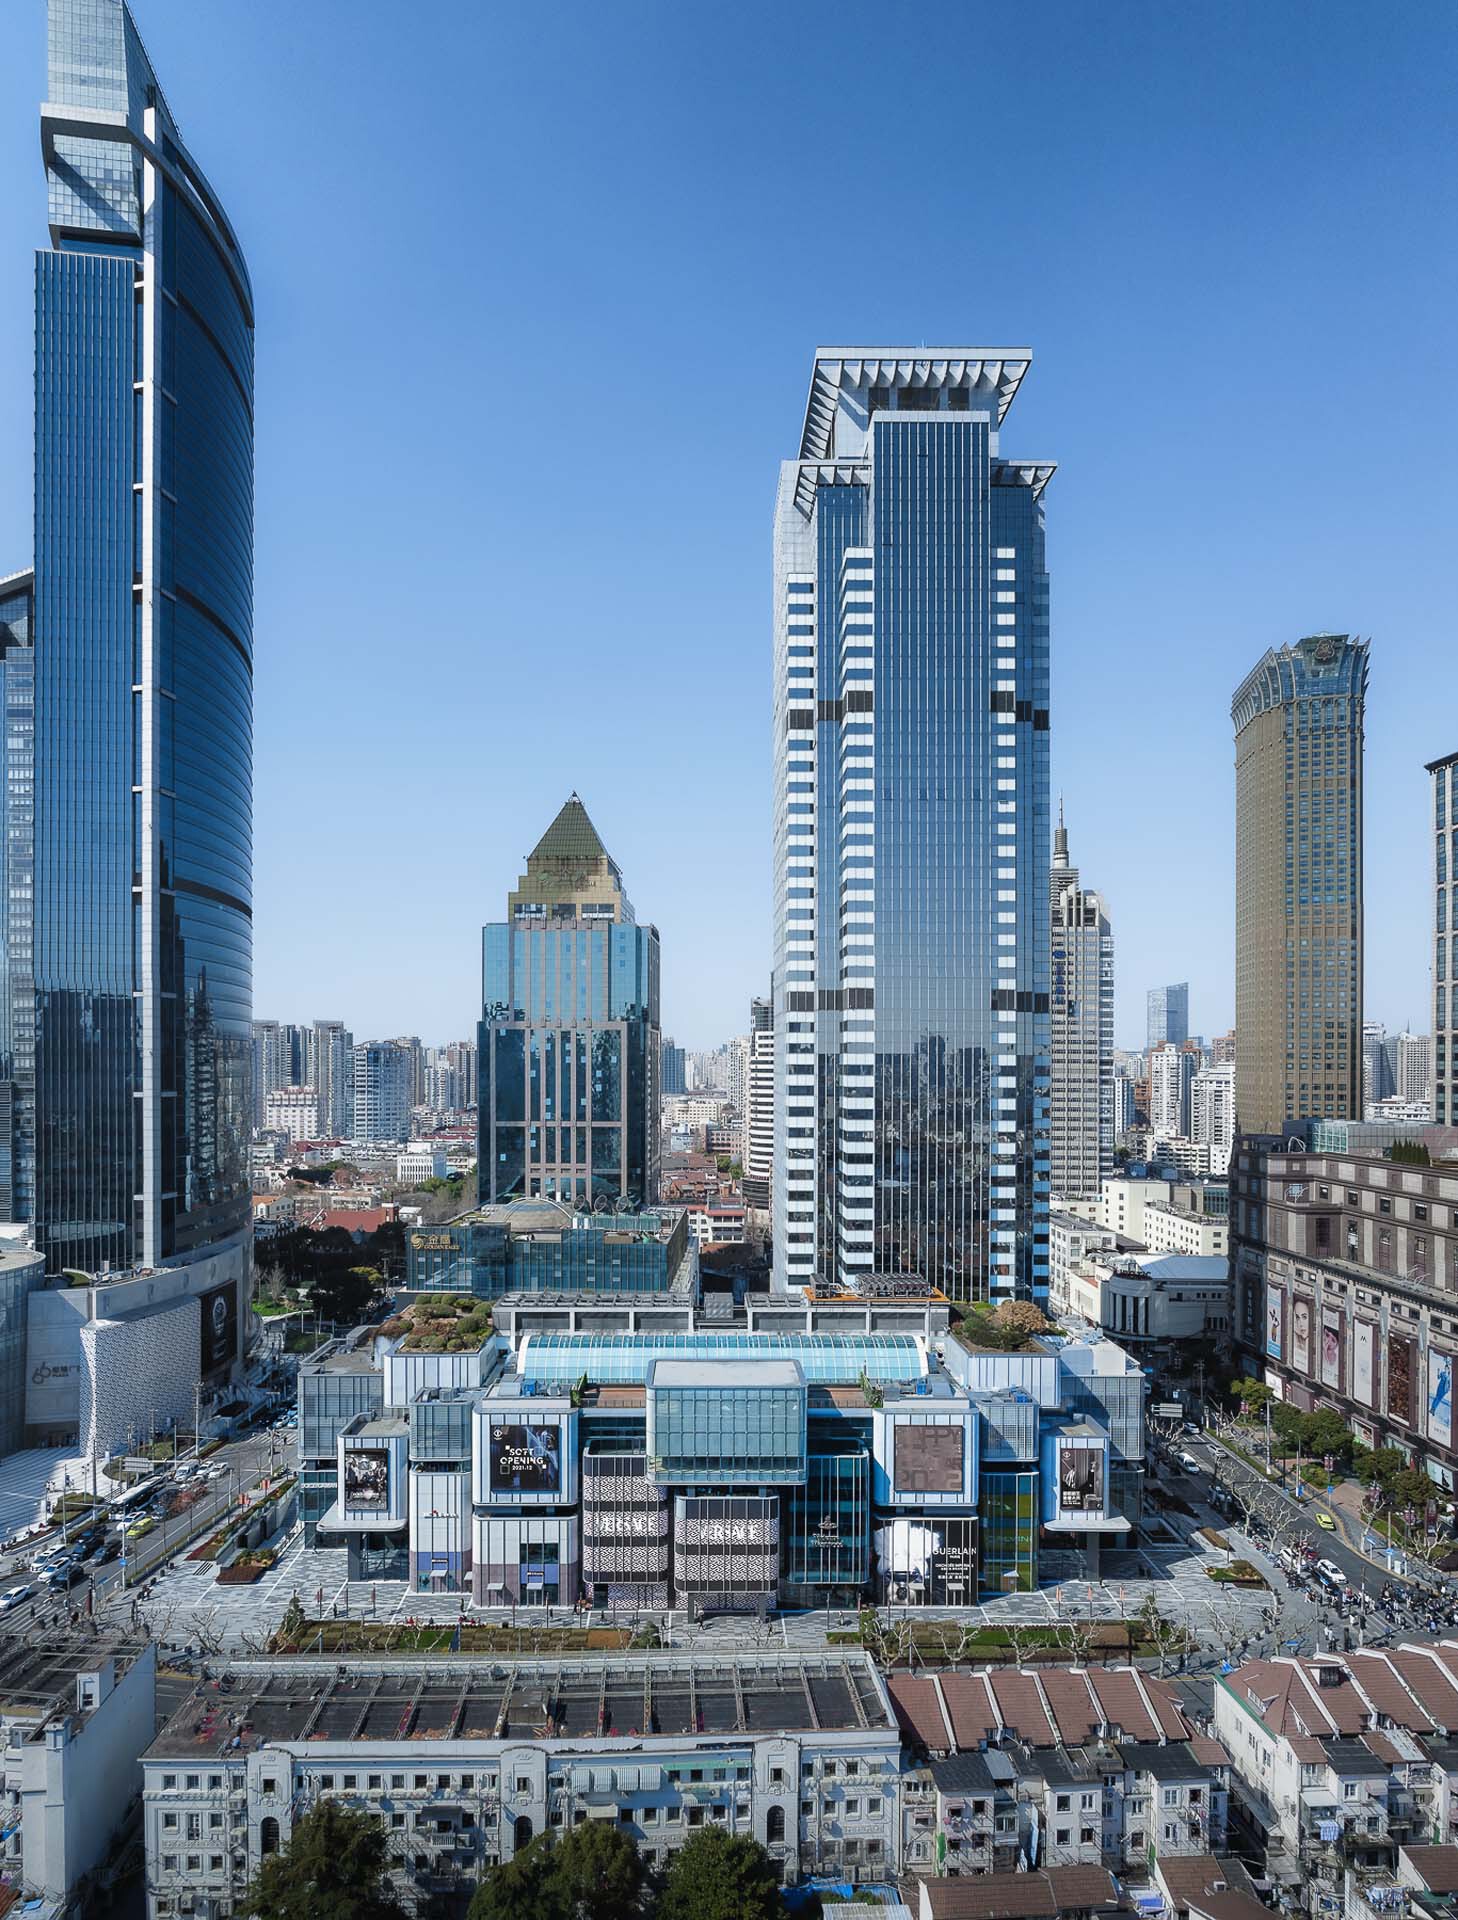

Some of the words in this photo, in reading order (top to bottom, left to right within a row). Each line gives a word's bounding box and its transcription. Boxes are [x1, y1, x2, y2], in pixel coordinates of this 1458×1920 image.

[509, 1448, 534, 1456] SOFT
[499, 1456, 544, 1465] OPENING
[932, 1547, 977, 1556] GUERLAIN
